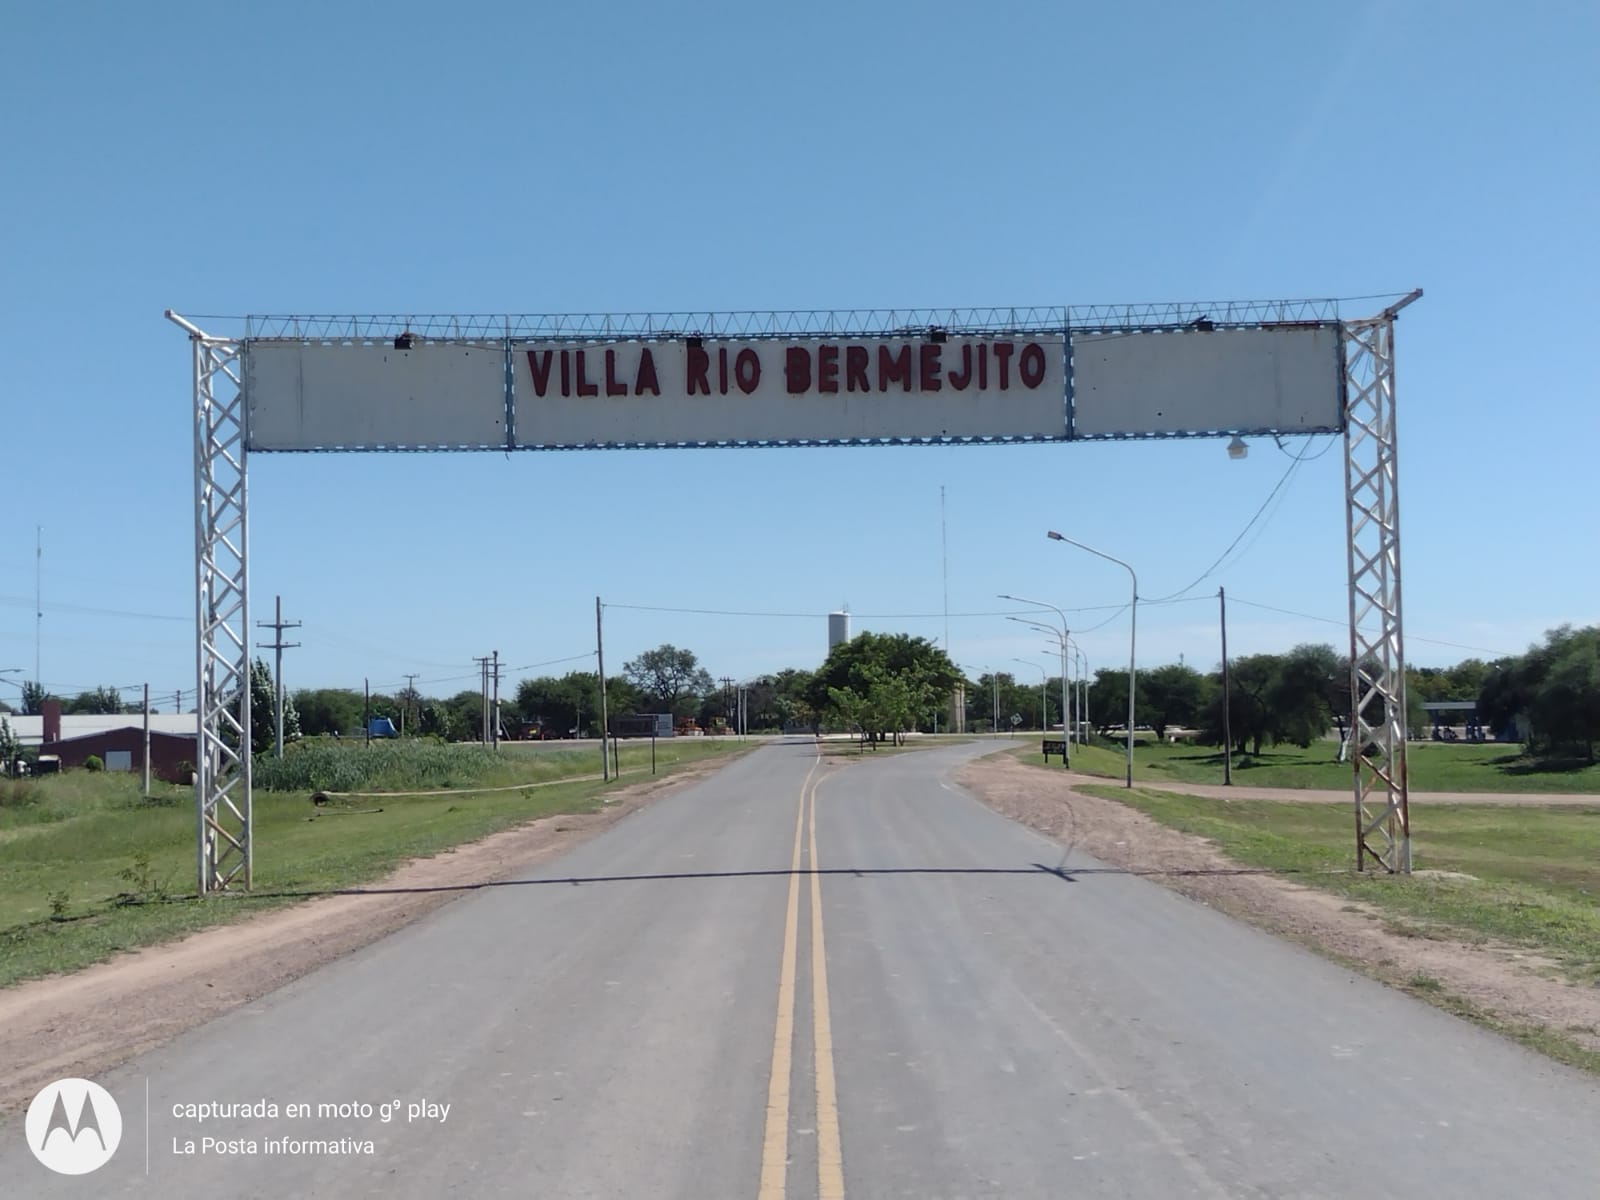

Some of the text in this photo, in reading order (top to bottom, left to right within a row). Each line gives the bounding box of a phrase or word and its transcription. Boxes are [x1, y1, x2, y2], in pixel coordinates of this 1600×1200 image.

[527, 342, 1047, 397] VILLA RIO BERMEJITO
